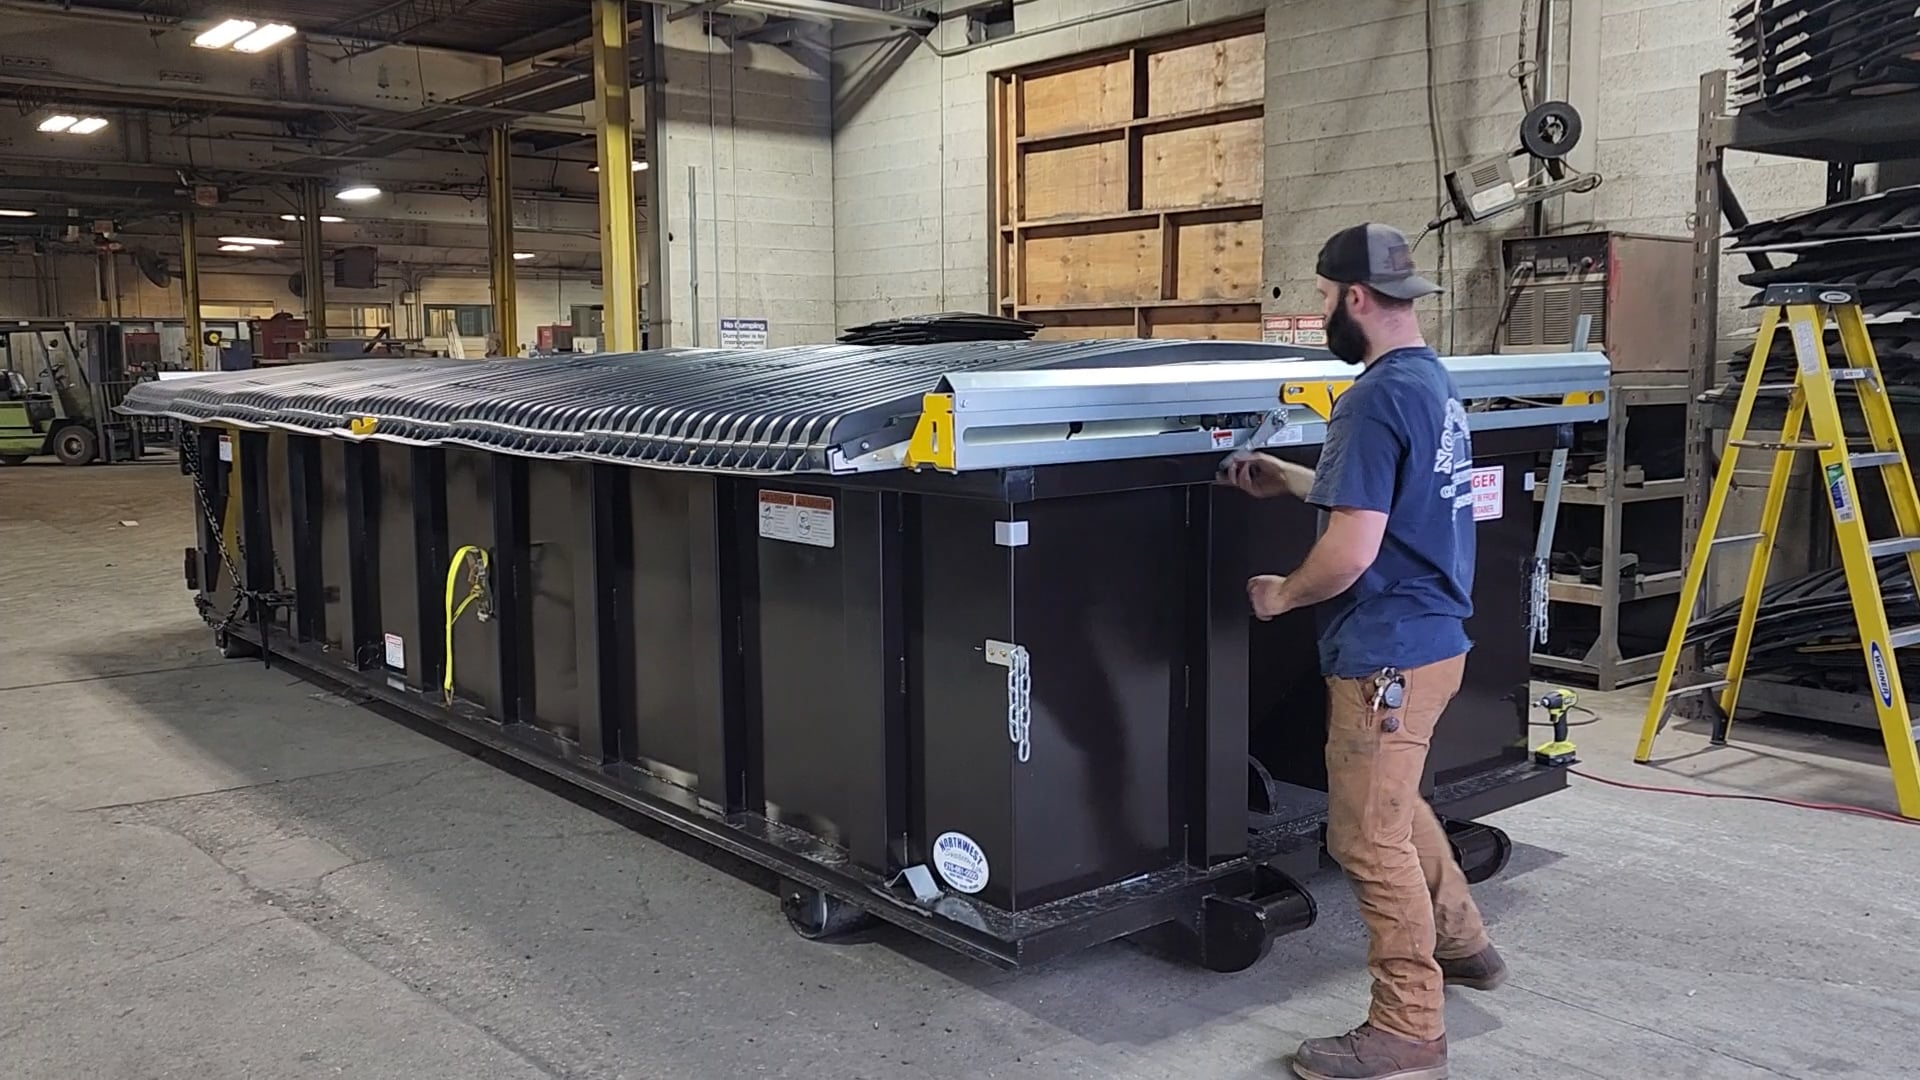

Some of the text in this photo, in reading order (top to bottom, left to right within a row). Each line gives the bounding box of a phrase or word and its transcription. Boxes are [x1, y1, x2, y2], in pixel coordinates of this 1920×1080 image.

[723, 321, 765, 330] No Dumping
[1472, 473, 1496, 488] GER
[1874, 655, 1889, 694] WERNER
[939, 836, 983, 866] NORTHWEST
